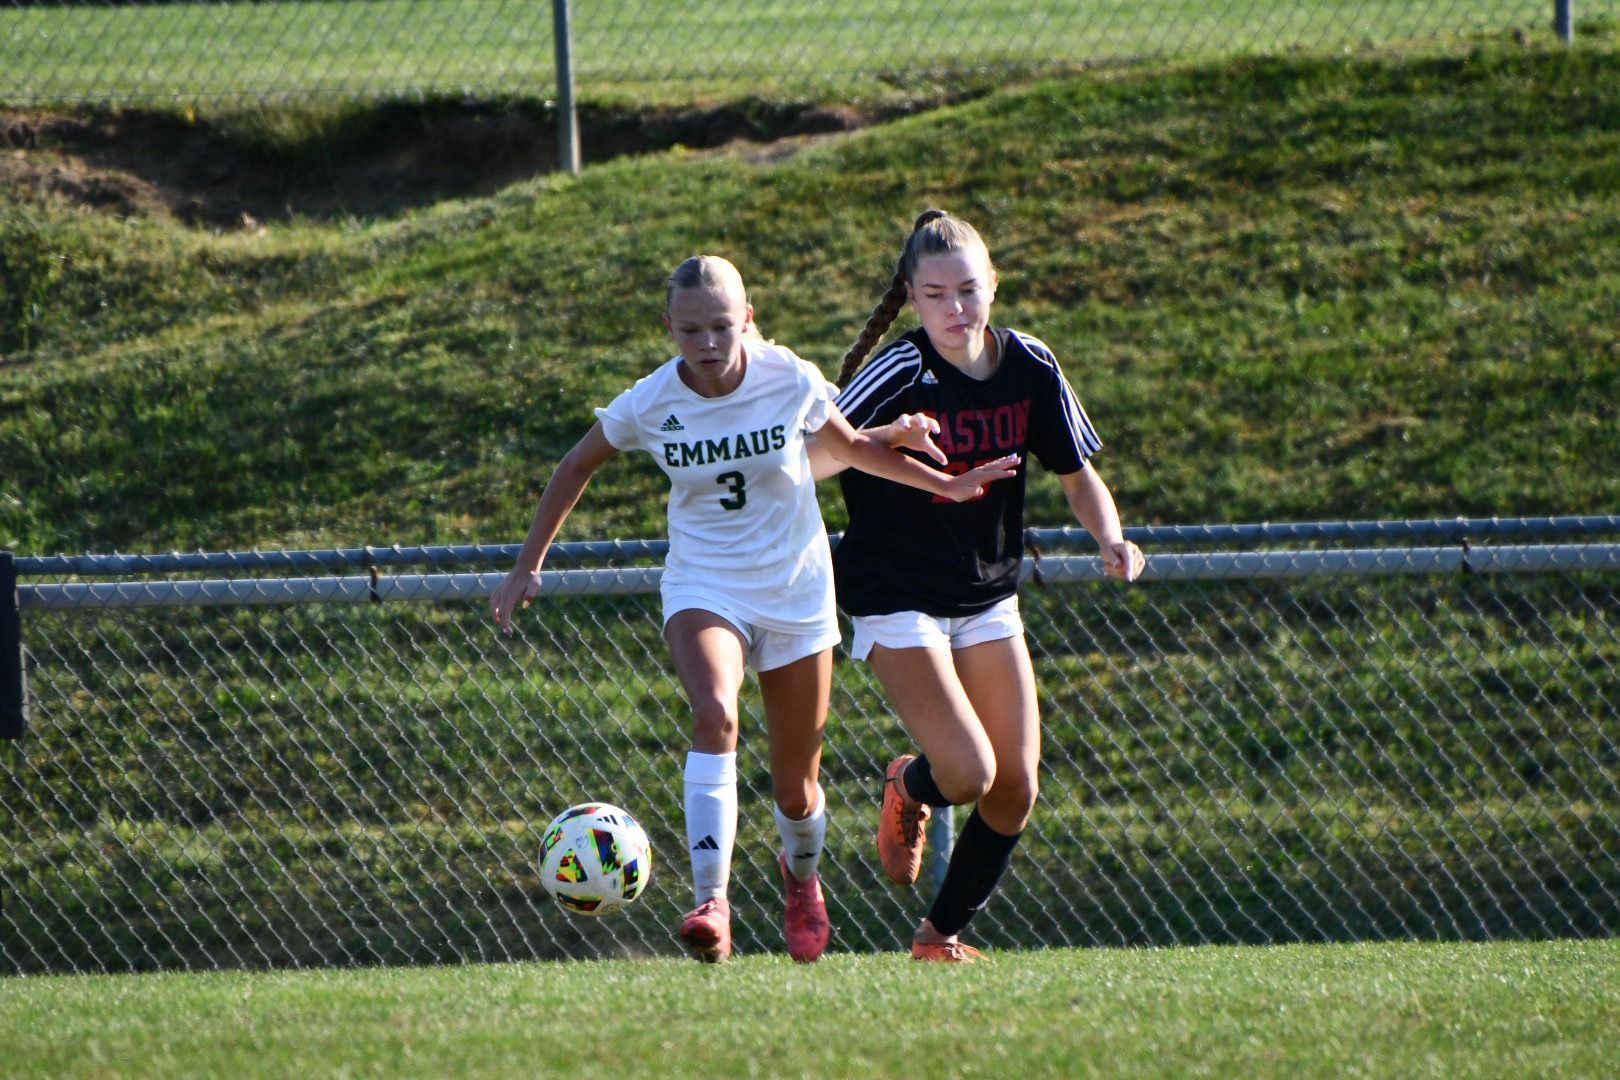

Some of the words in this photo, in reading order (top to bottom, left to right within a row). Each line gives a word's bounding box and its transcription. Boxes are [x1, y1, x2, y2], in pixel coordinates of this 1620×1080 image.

[660, 424, 685, 432] adidas
[663, 424, 786, 468] EMMAUS
[917, 399, 1032, 455] ASTON
[716, 470, 746, 511] 3
